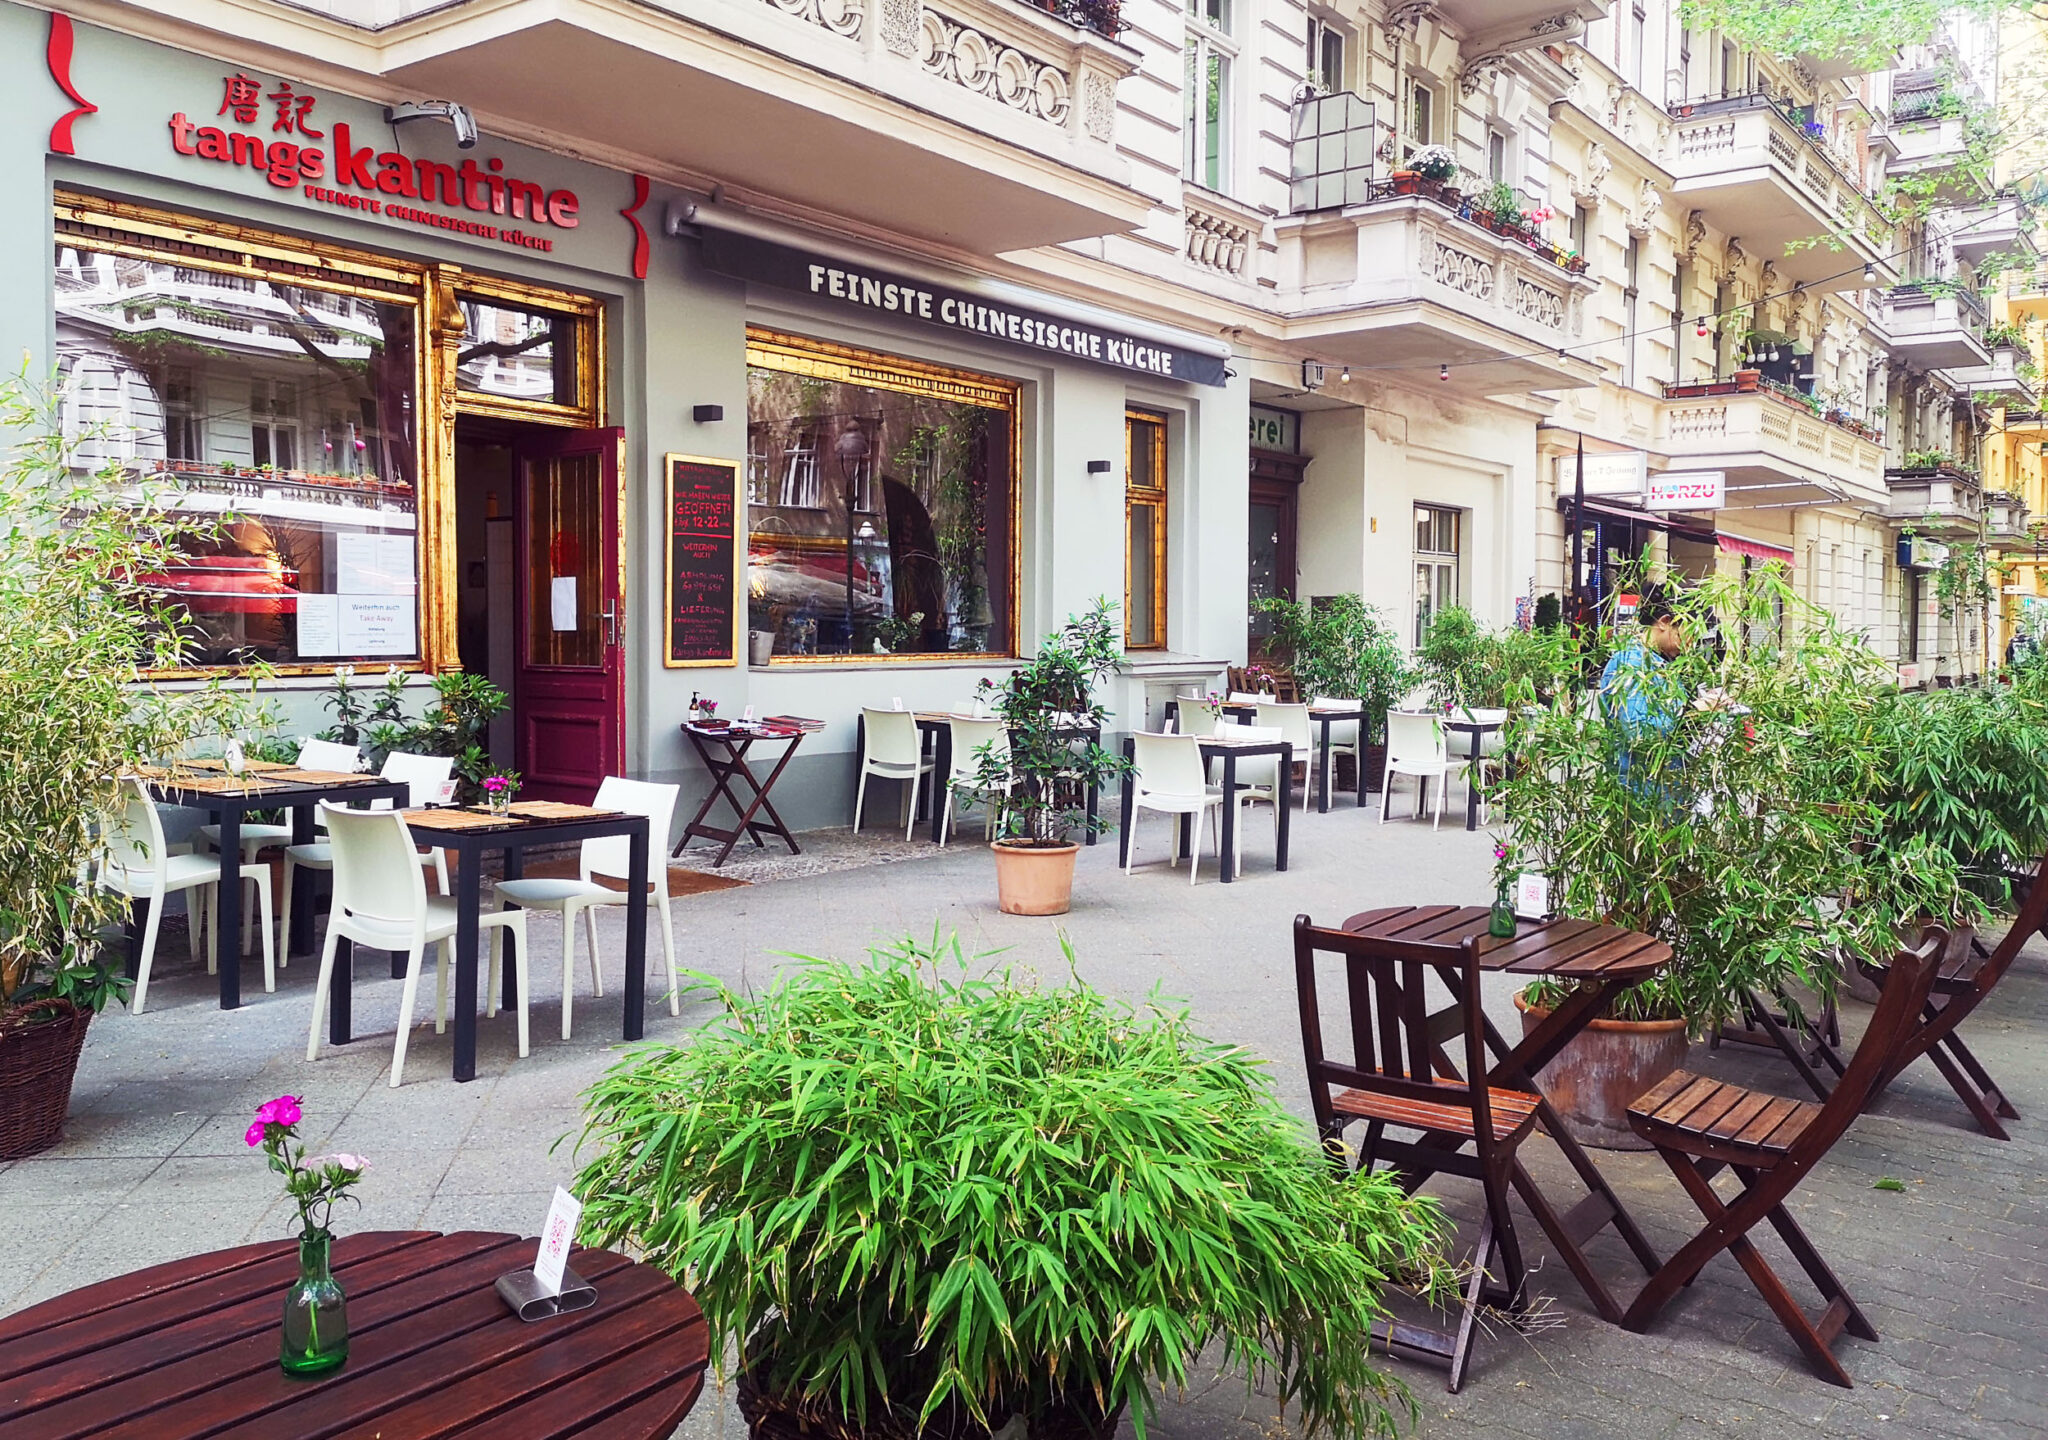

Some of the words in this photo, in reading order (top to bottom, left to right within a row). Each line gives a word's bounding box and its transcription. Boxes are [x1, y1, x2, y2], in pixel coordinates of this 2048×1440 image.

[216, 73, 325, 138] 唐記
[168, 112, 326, 189] tangs
[332, 122, 580, 229] kantine
[303, 184, 382, 214] FEINSTE
[385, 203, 498, 240] CHINESISCHE
[501, 229, 554, 252] KÜCHE
[807, 264, 934, 319] FEINSTE
[940, 298, 1102, 359] CHINESISCHE
[1105, 337, 1174, 375] KÜCHE
